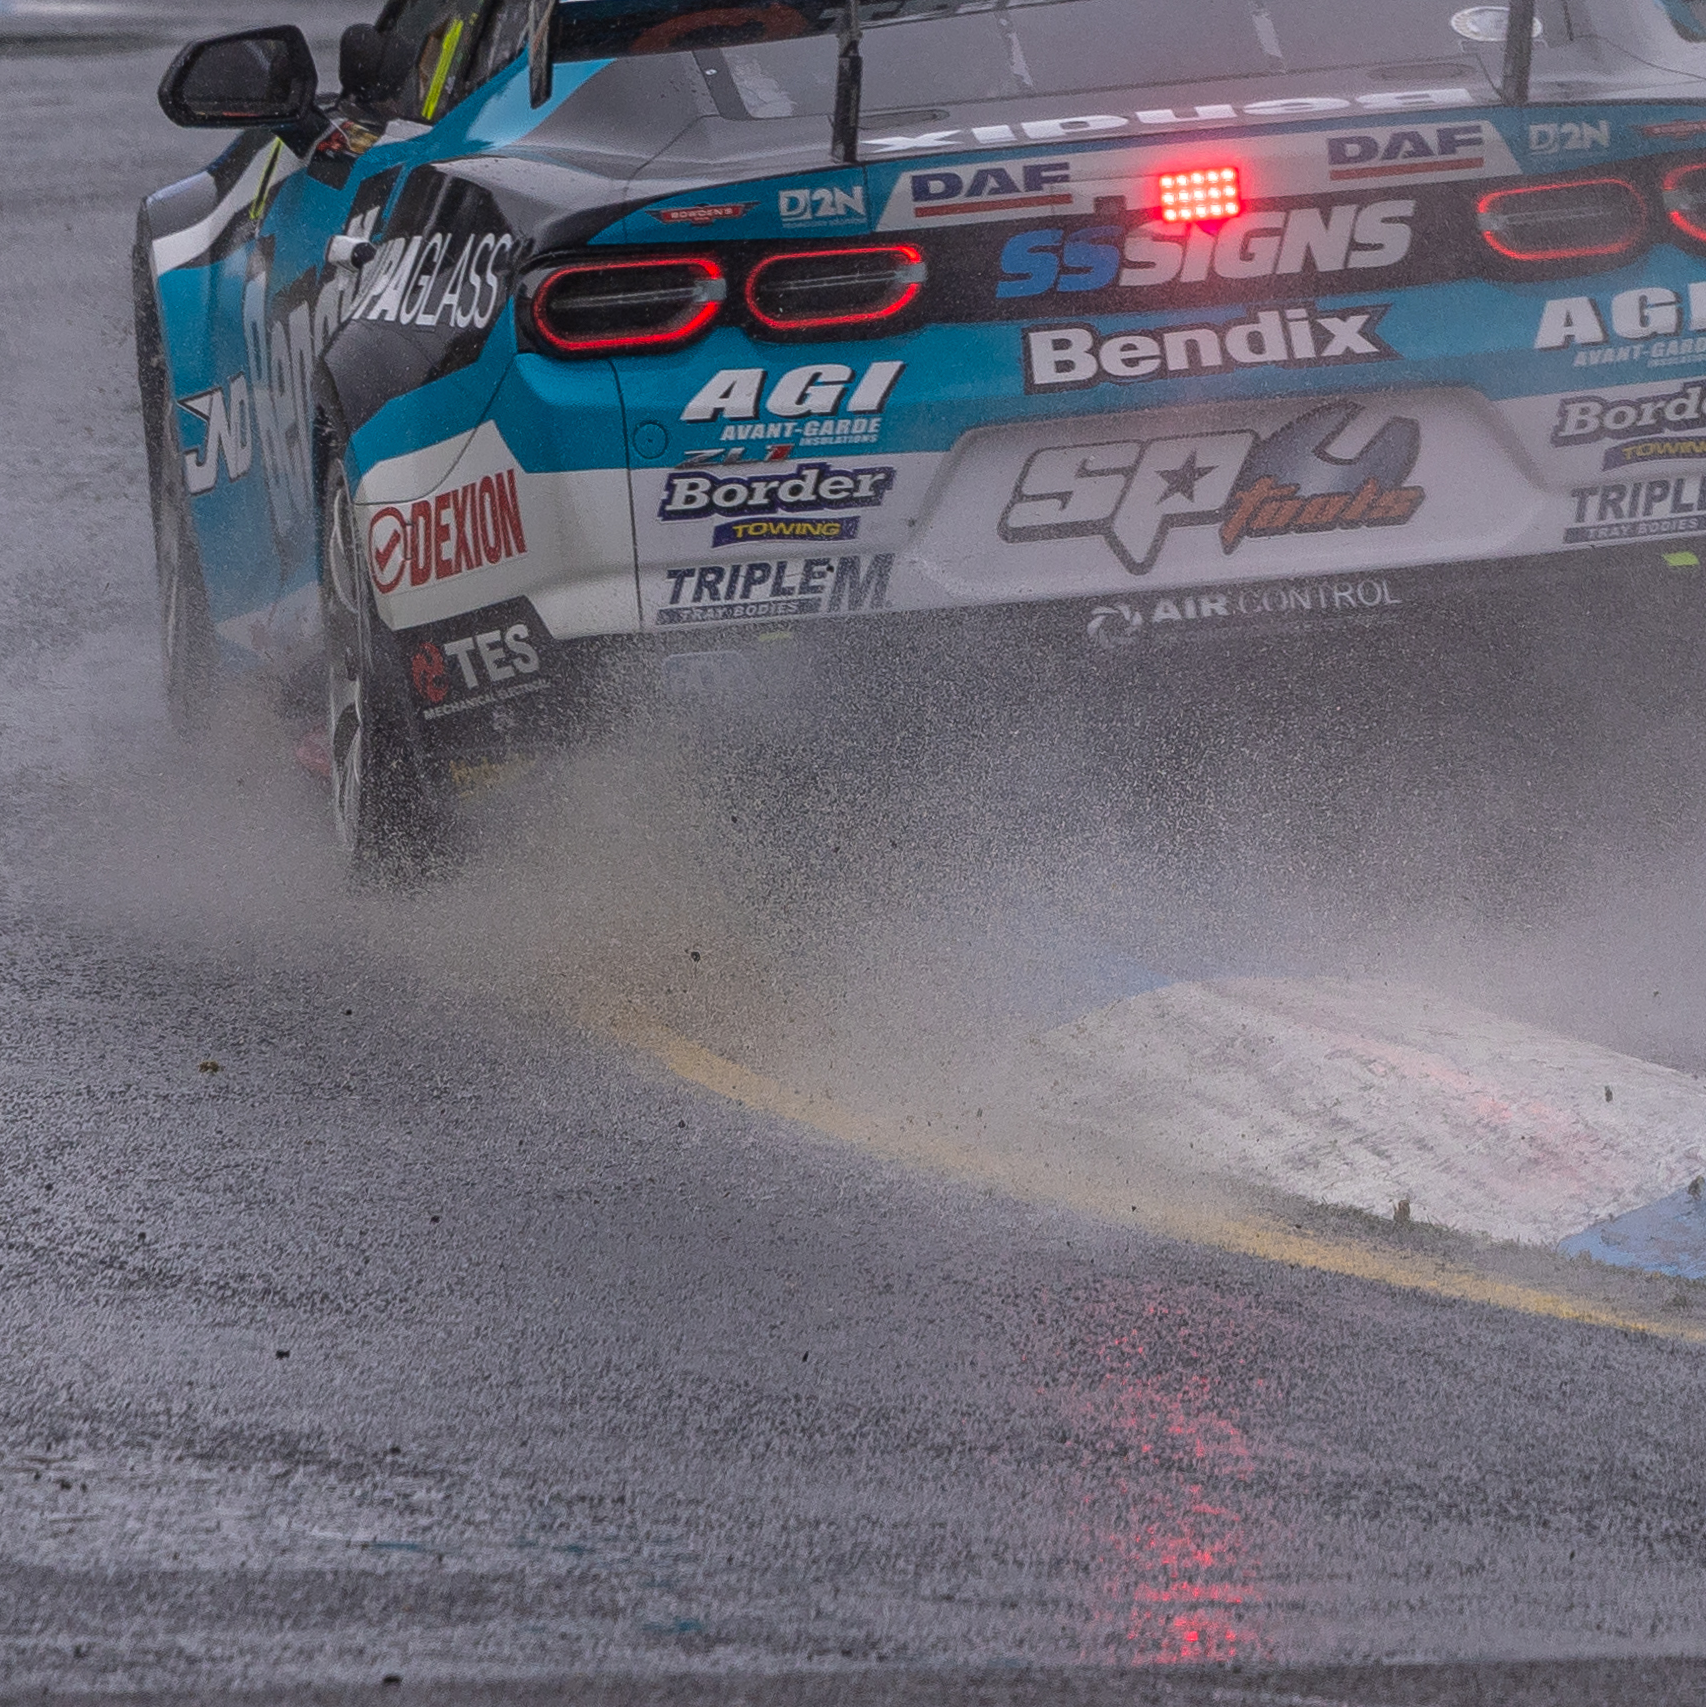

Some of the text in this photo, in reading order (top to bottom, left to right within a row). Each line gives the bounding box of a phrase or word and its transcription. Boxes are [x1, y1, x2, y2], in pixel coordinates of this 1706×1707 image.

[859, 89, 1473, 154] Bendix
[1326, 125, 1485, 165] DAF
[778, 185, 867, 221] D2N
[910, 161, 1071, 202] DAF
[1027, 308, 1380, 385] Bendix
[679, 360, 906, 424] AGI
[719, 417, 882, 441] AVANT-GARDE
[663, 469, 889, 513] Border
[999, 429, 1260, 575] SP
[408, 468, 528, 587] DEXION
[732, 521, 842, 539] TOWING
[680, 602, 799, 622] TRAY BODIES
[1151, 580, 1403, 625] AIR CONTROL
[443, 622, 541, 691] TES
